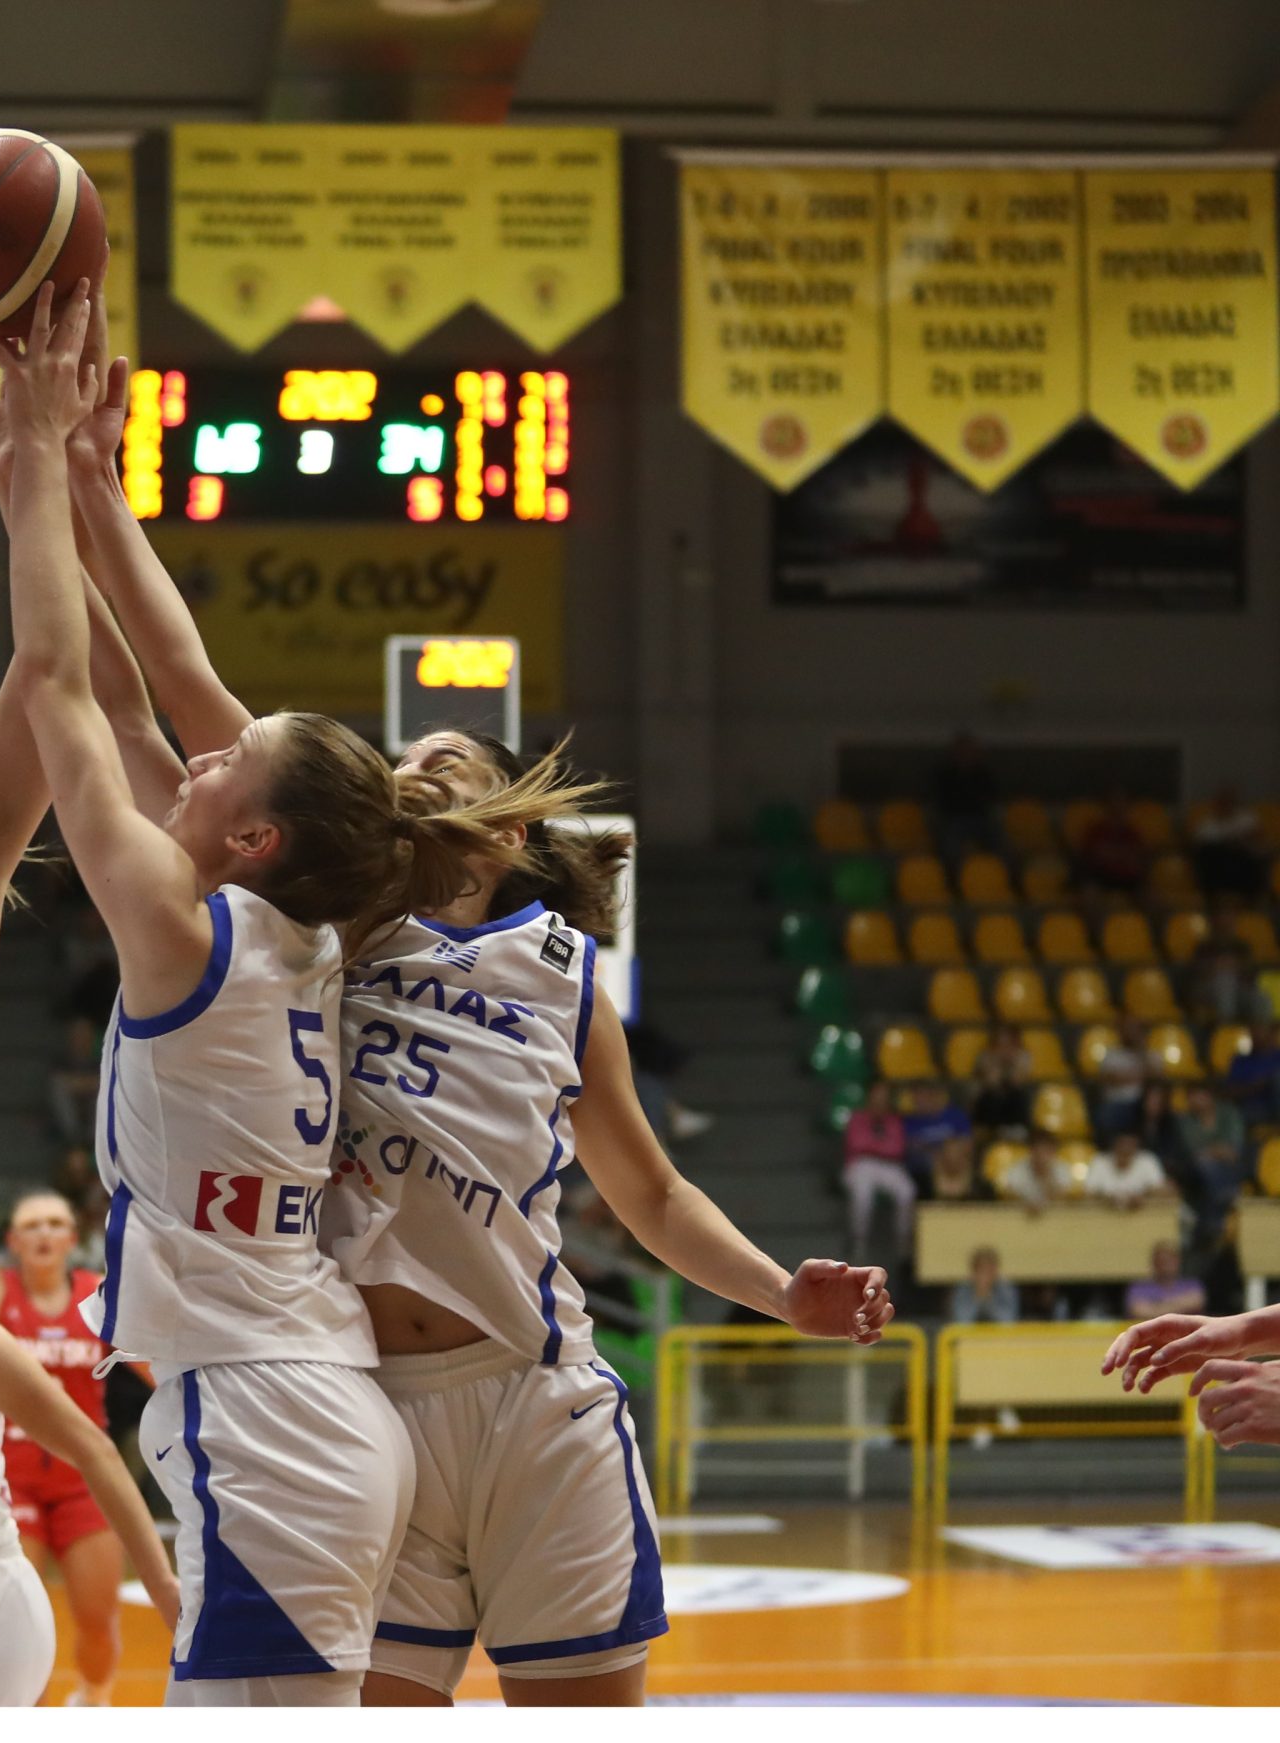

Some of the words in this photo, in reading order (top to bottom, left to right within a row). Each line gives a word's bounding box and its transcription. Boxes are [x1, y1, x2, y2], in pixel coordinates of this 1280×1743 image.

[548, 938, 569, 958] FIBA
[287, 1008, 332, 1145] 5
[350, 1020, 451, 1099] 25
[275, 1184, 323, 1235] EK
